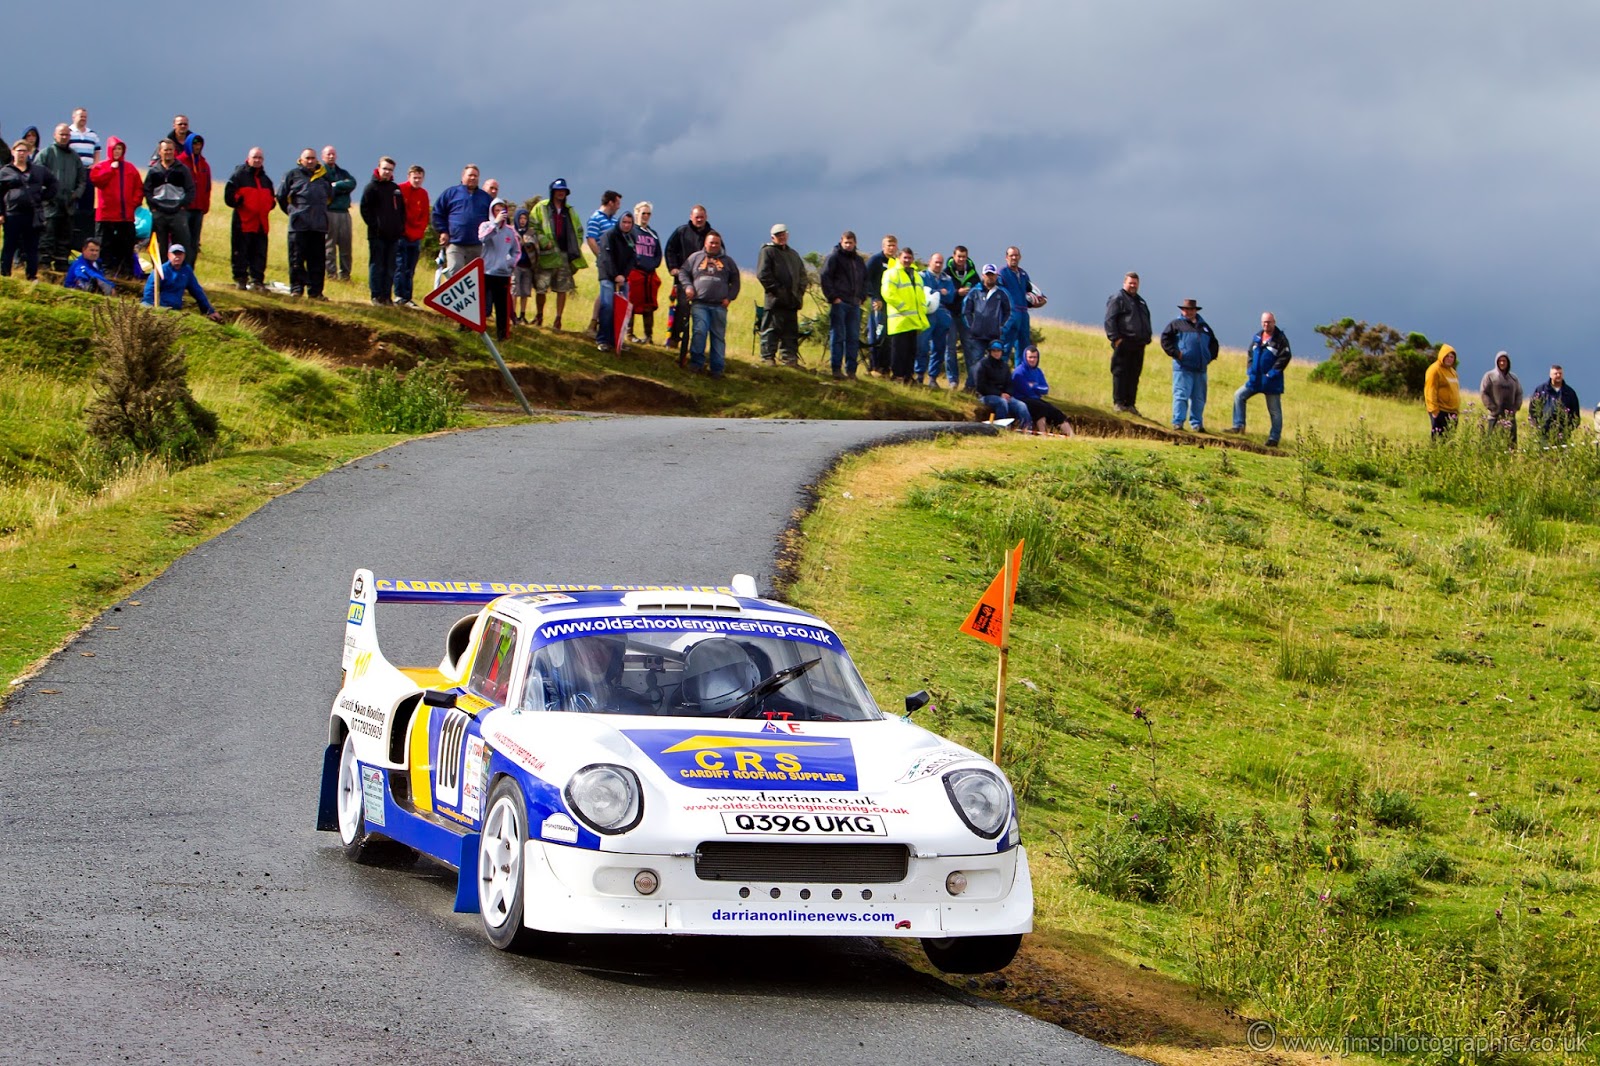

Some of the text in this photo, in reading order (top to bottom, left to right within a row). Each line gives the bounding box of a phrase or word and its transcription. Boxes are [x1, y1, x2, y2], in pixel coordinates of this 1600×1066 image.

[440, 275, 476, 306] GIVE
[453, 291, 477, 312] WAY
[541, 617, 833, 646] www.oldschoolengineering.co.uk
[438, 711, 468, 789] 110
[680, 769, 847, 782] CARDIFF ROOFING SUPPLIES
[683, 802, 910, 815] www.oldschoolengineering.co.uk
[706, 791, 878, 806] www.darrian.co.uk
[735, 814, 876, 834] Q396 UKG
[711, 909, 896, 923] darrianonlinenews.com
